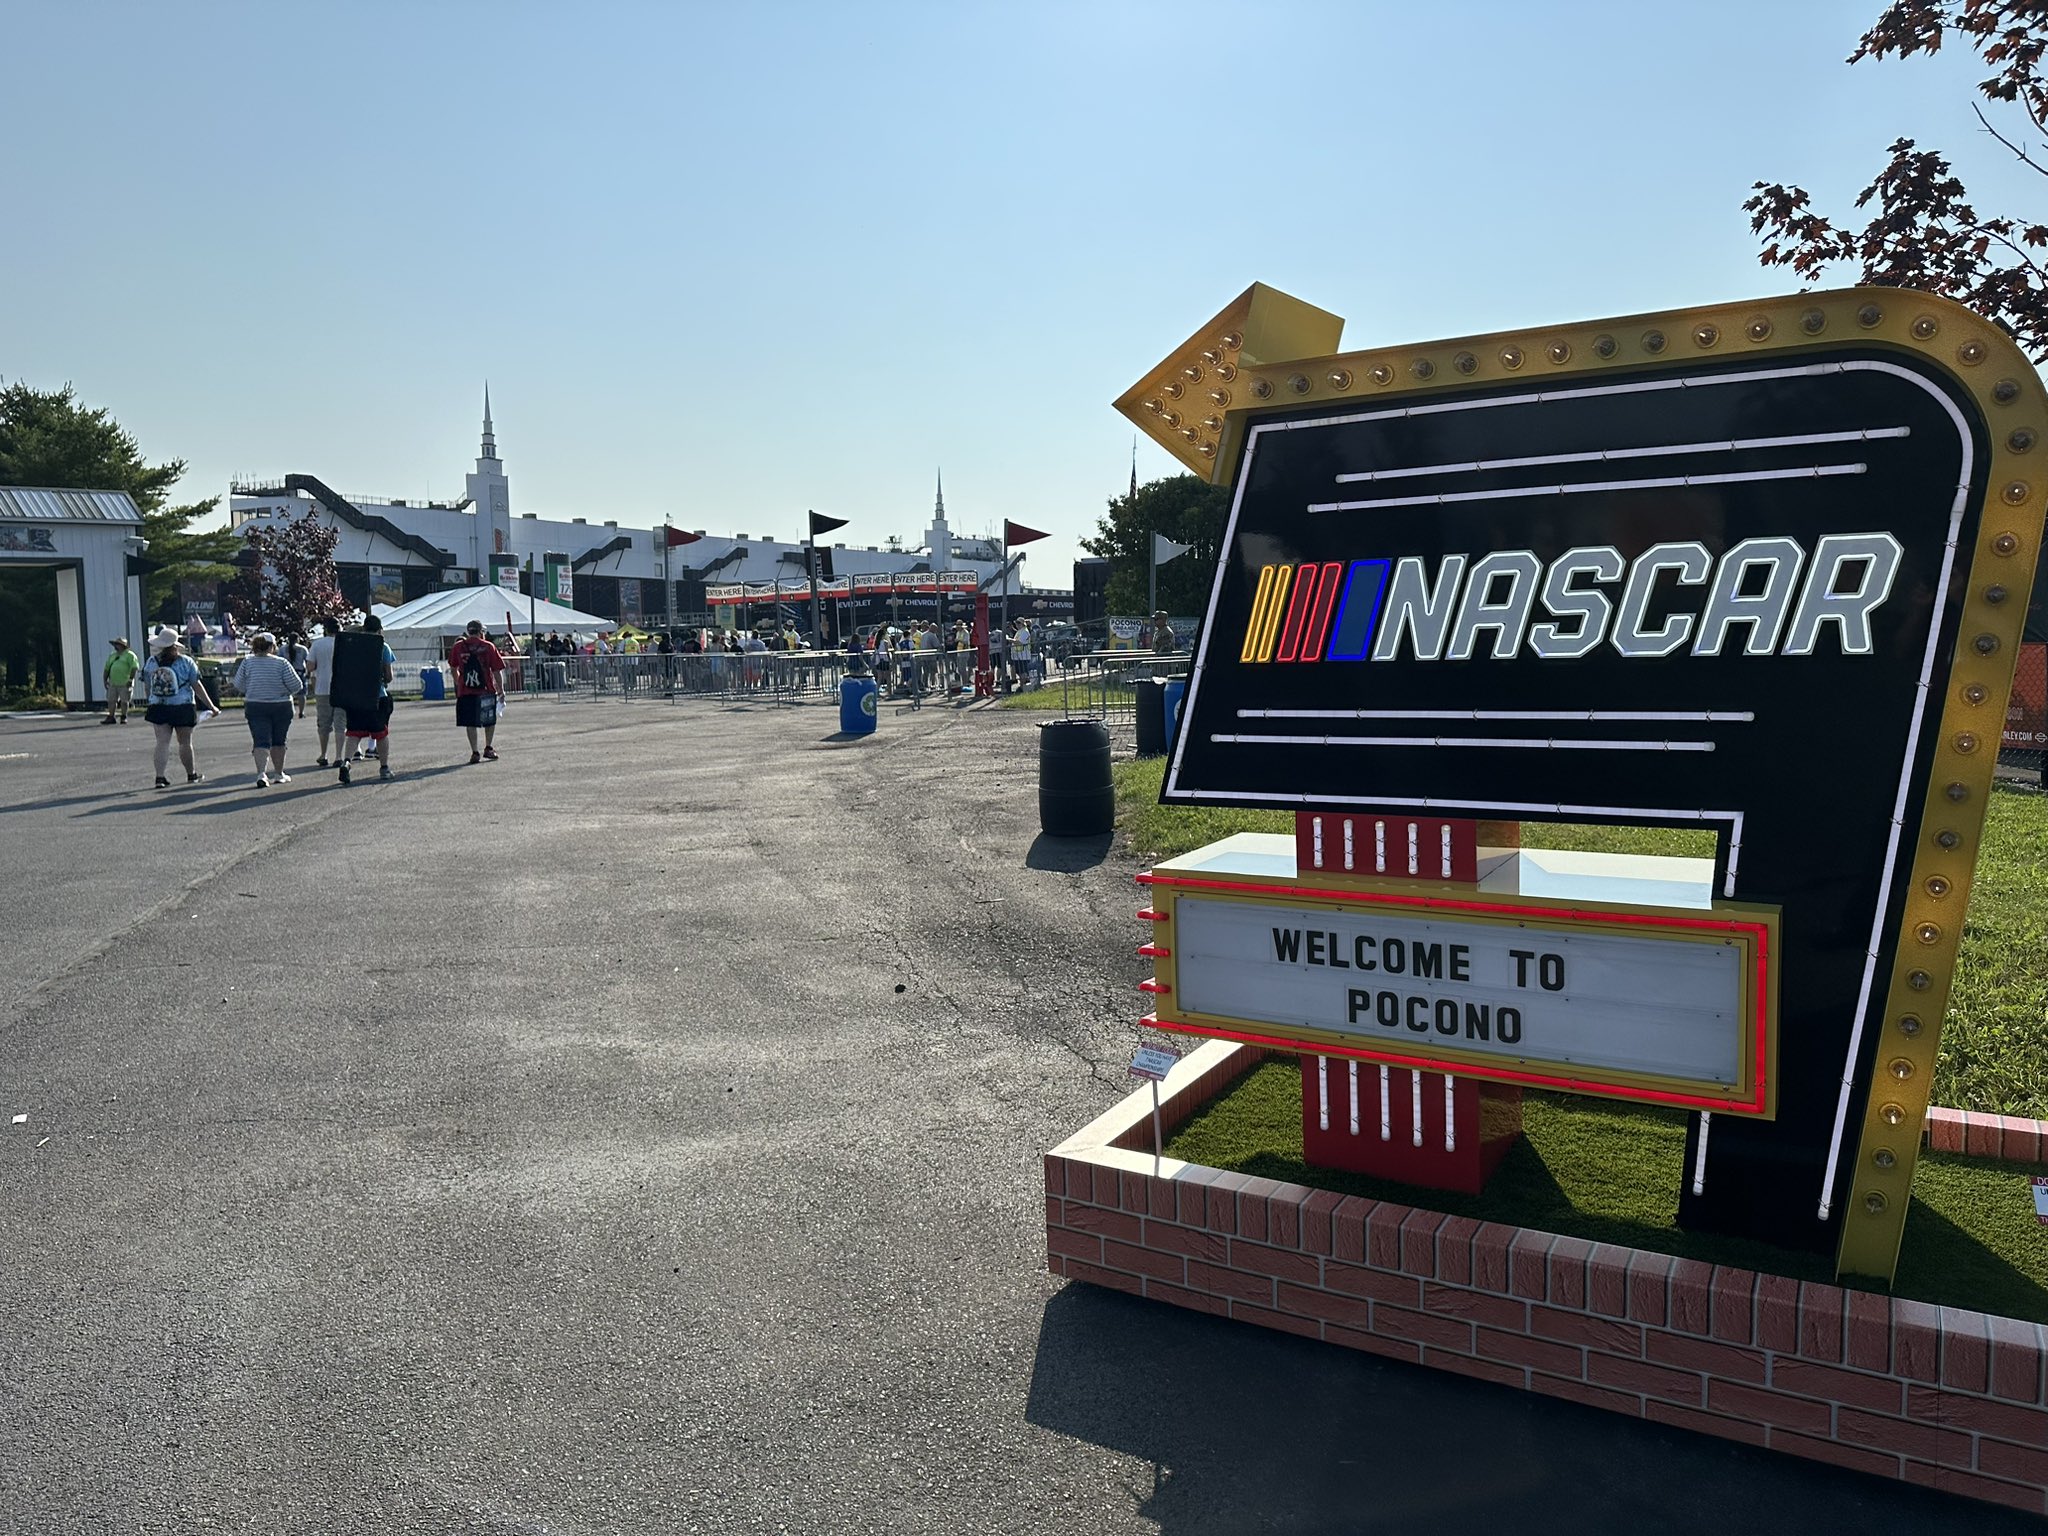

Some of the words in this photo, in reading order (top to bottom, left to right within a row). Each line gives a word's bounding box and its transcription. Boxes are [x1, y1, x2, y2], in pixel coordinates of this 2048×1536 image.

[854, 576, 872, 584] ENTER
[872, 574, 890, 584] HERE
[894, 575, 915, 583] ENTER
[916, 574, 935, 582] HERE
[940, 574, 958, 582] ENTER
[959, 574, 976, 582] HERE
[706, 588, 722, 596] ENTER
[724, 587, 742, 596] HERE
[1371, 531, 1904, 662] NASCAR
[465, 670, 480, 687] NY
[1272, 927, 1470, 982] WELCOME
[1509, 949, 1565, 992] TO
[1347, 988, 1522, 1044] POCONO
